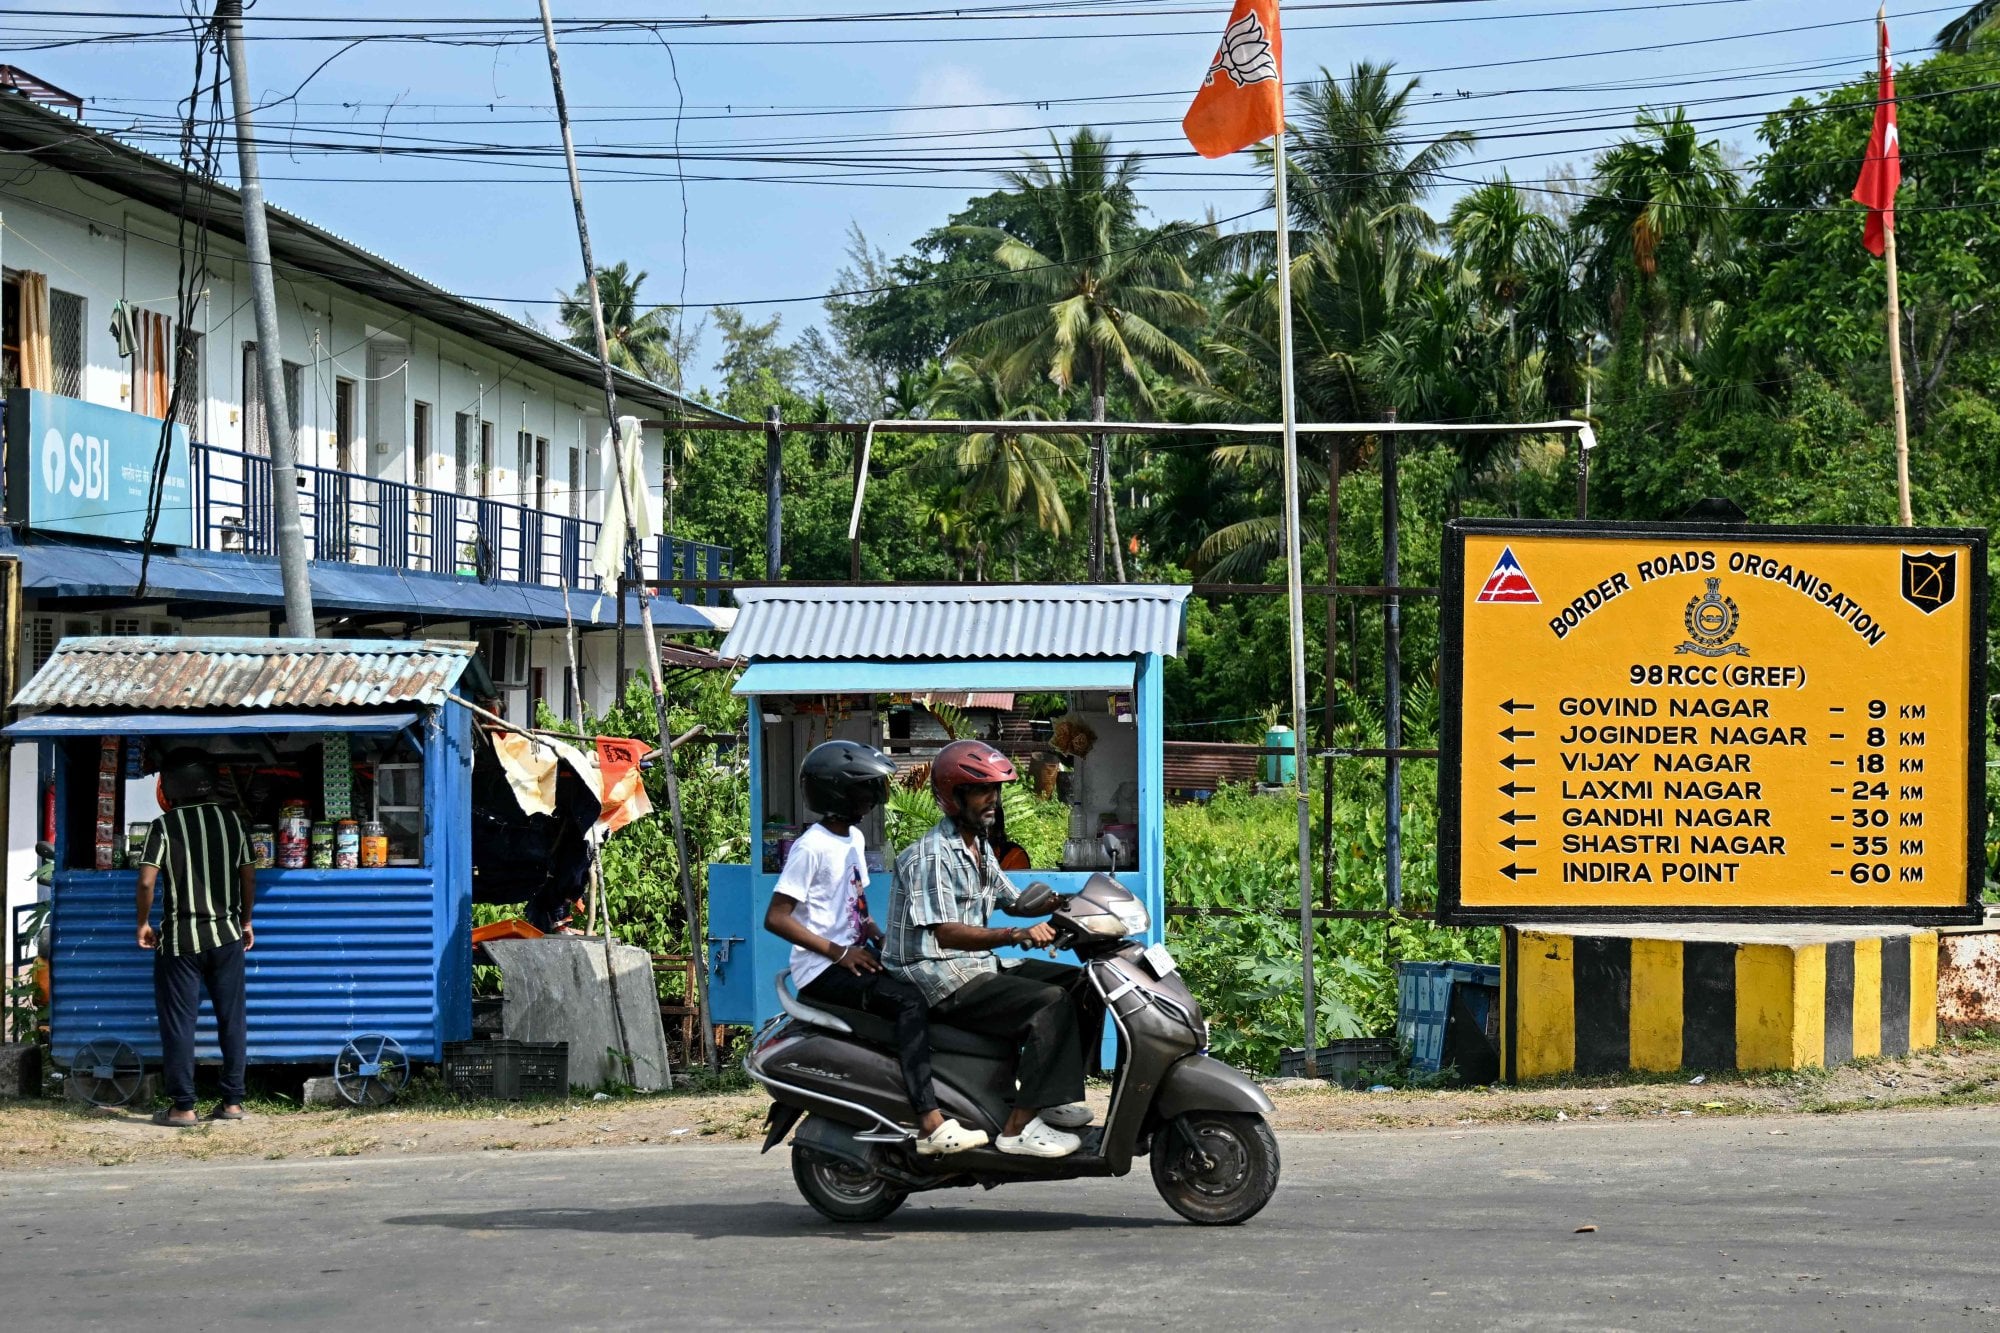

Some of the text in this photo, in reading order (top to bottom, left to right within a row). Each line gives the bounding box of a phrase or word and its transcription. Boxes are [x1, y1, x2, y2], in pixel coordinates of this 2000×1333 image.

[69, 432, 109, 501] SBI
[1548, 550, 1886, 646] BORDER ROADS ORGANISATION
[1559, 697, 1658, 717] GOVIND
[1669, 698, 1769, 718] NAGAR
[1868, 699, 1887, 719] 9
[1900, 704, 1926, 719] KM
[1560, 725, 1698, 745] JOGINDER
[1710, 726, 1807, 746] NAGAR
[1866, 727, 1886, 748] 8
[1899, 732, 1925, 746] KM
[1559, 752, 1640, 772] VIJAY
[1654, 753, 1751, 773] NAGAR
[1856, 753, 1885, 774] 18
[1899, 758, 1924, 773] KM
[1562, 780, 1653, 800] LAXMI
[1664, 781, 1762, 800] NAGAR
[1852, 780, 1890, 801] 24
[1900, 785, 1923, 800] KM
[1562, 807, 1663, 827] GANDHI
[1675, 808, 1771, 827] NAGAR
[1852, 808, 1889, 828] 30
[1899, 812, 1923, 827] KM
[1562, 833, 1680, 854] SHASTRI
[1690, 835, 1786, 855] NAGAR
[1852, 836, 1888, 856] 35
[1900, 839, 1923, 856] KM
[1563, 862, 1652, 883] INDIRA
[1662, 862, 1740, 883] POINT
[1850, 862, 1891, 884] 60
[1900, 866, 1923, 882] KM
